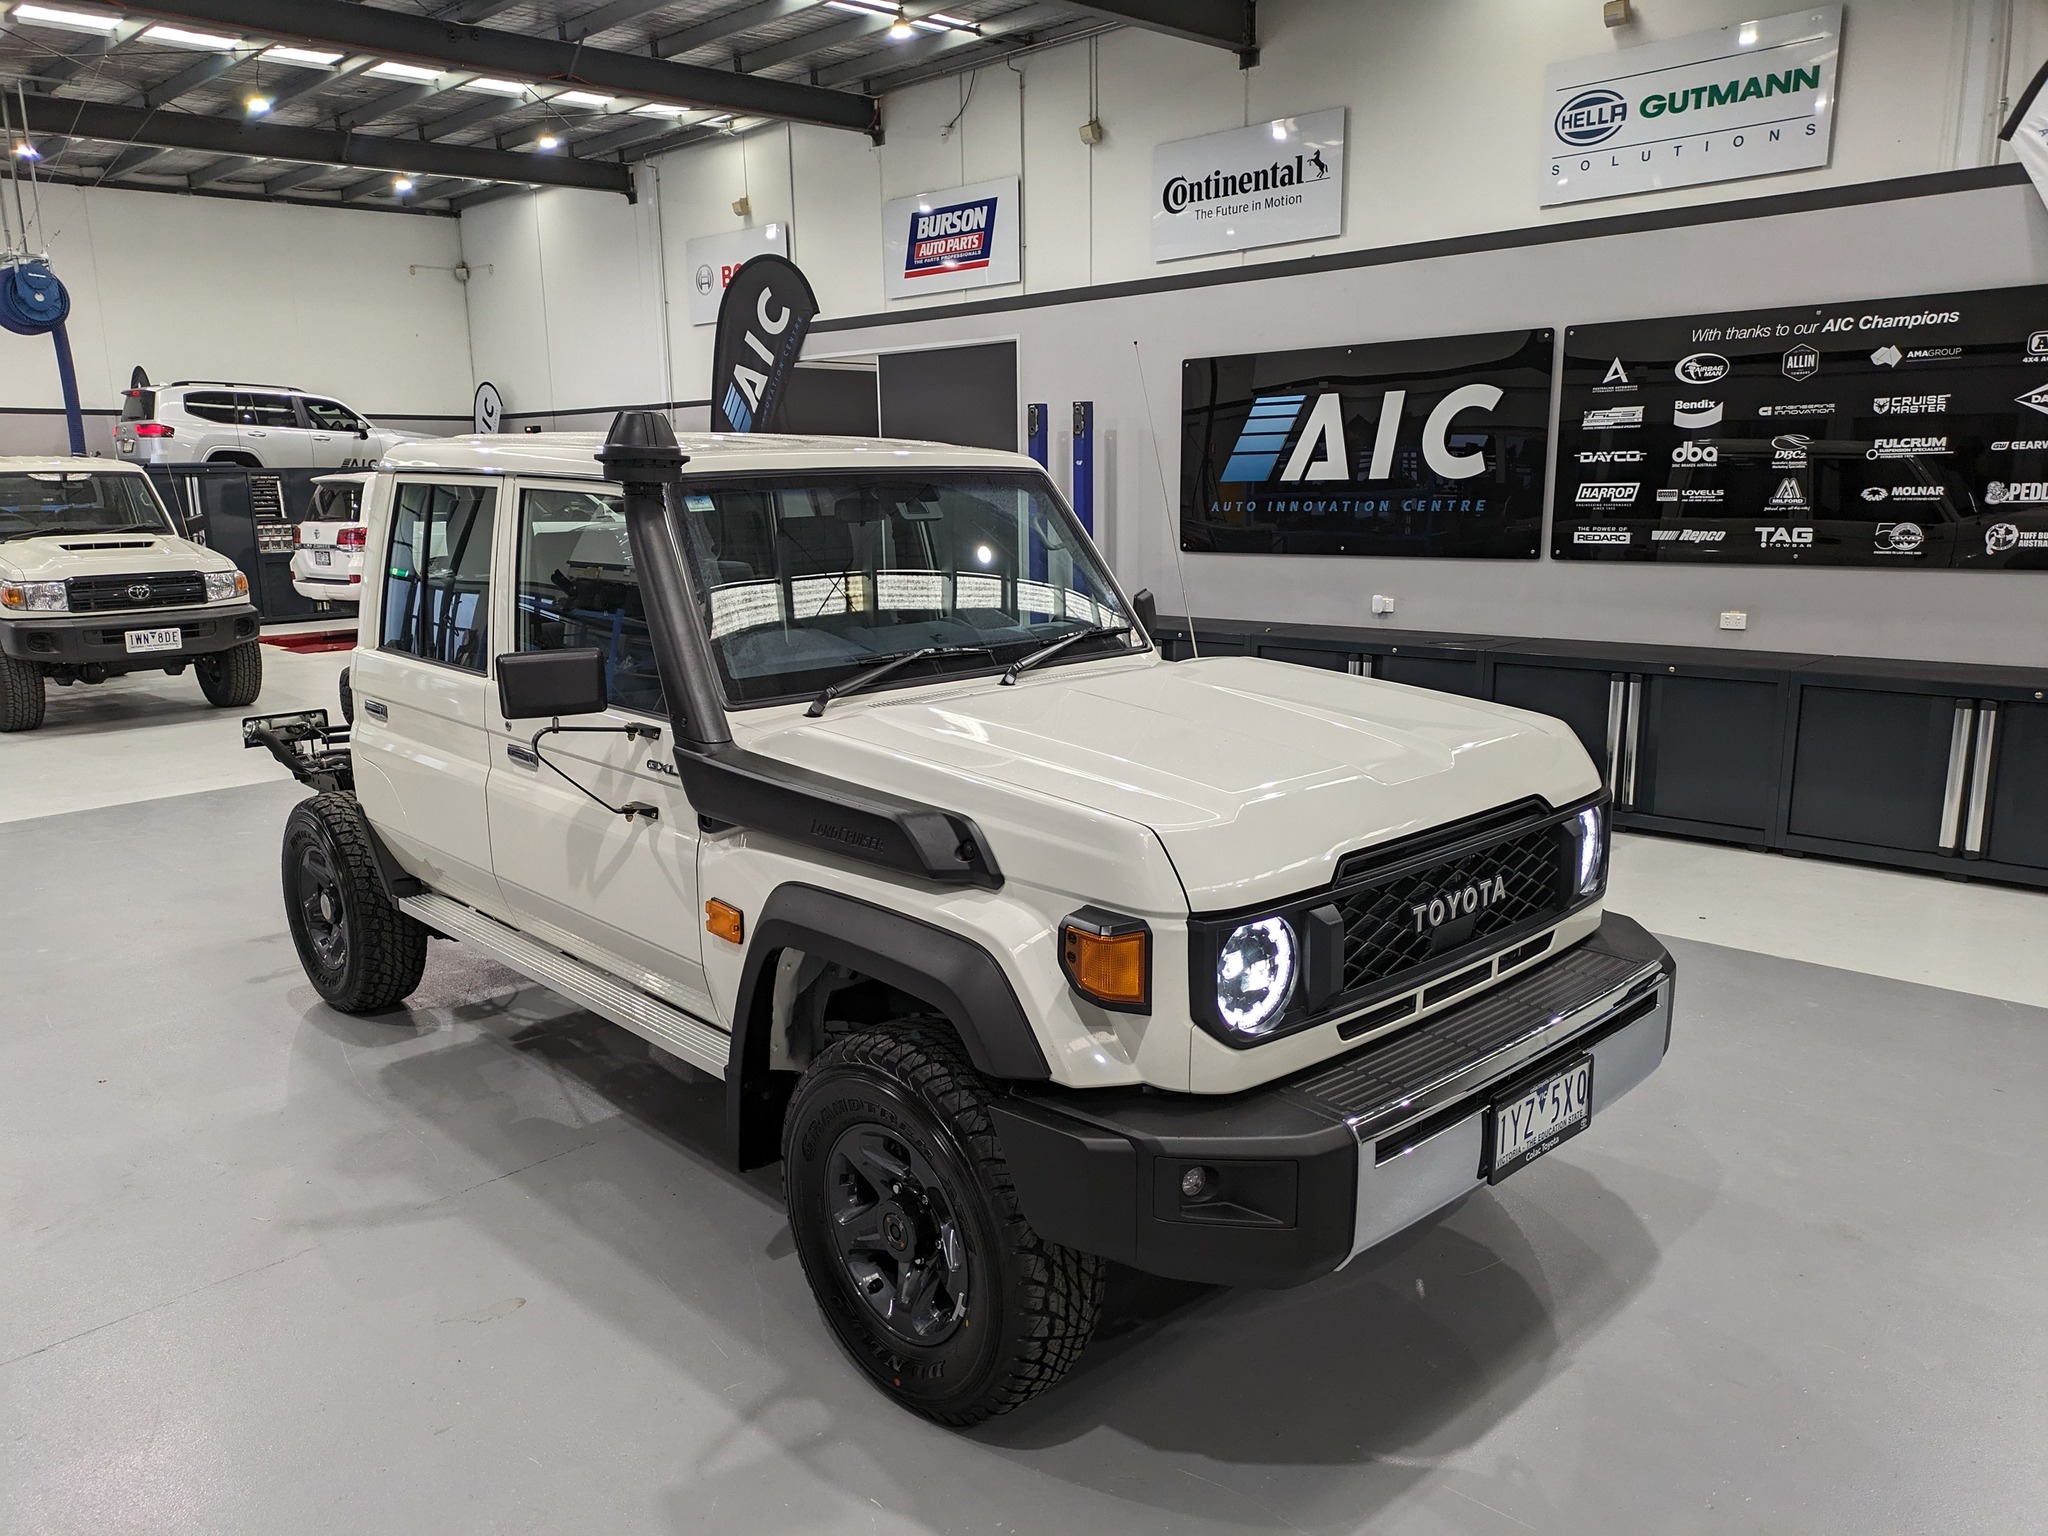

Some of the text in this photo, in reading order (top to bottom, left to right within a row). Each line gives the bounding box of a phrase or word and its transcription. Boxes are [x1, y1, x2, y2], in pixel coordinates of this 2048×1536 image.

[1639, 64, 1821, 118] GUTMANN
[1562, 102, 1628, 130] HELLA
[1551, 123, 1817, 176] SOLUTIONS
[1162, 154, 1305, 215] Continental
[1195, 194, 1303, 220] The Future in Motion
[917, 206, 988, 239] BURSON
[919, 235, 979, 257] AUTO PARTS
[1691, 310, 1960, 343] With thanks to our AIC Champions
[733, 286, 791, 413] AIC
[1694, 365, 1724, 373] AIRBAG
[1786, 353, 1816, 369] ALLIN
[1674, 399, 1716, 410] Bendix
[1890, 404, 1946, 414] MASTER
[1891, 394, 1951, 406] CRUISE
[1773, 408, 1836, 416] INNOVATION
[1279, 383, 1504, 481] AIC
[1672, 441, 1718, 463] dba
[1874, 437, 1947, 449] FULCRUM
[1579, 451, 1641, 463] DAYCO
[1580, 487, 1634, 498] HARROP
[1891, 486, 1945, 496] MOLNAR
[1211, 499, 1486, 512] AUTO INNOVATION CENTRE
[1577, 534, 1627, 542] REDARC
[1754, 527, 1814, 543] TAG
[2020, 531, 2037, 540] TUFF
[129, 633, 150, 646] 1WN
[1411, 875, 1506, 933] TOYOTA
[1500, 1098, 1535, 1154] 1YZ
[1551, 1069, 1587, 1123] 5XQ
[1526, 1135, 1538, 1149] THE
[1537, 1118, 1567, 1141] EDUCATION
[1567, 1108, 1584, 1125] STATE
[1525, 1135, 1560, 1162] Colac Toyota
